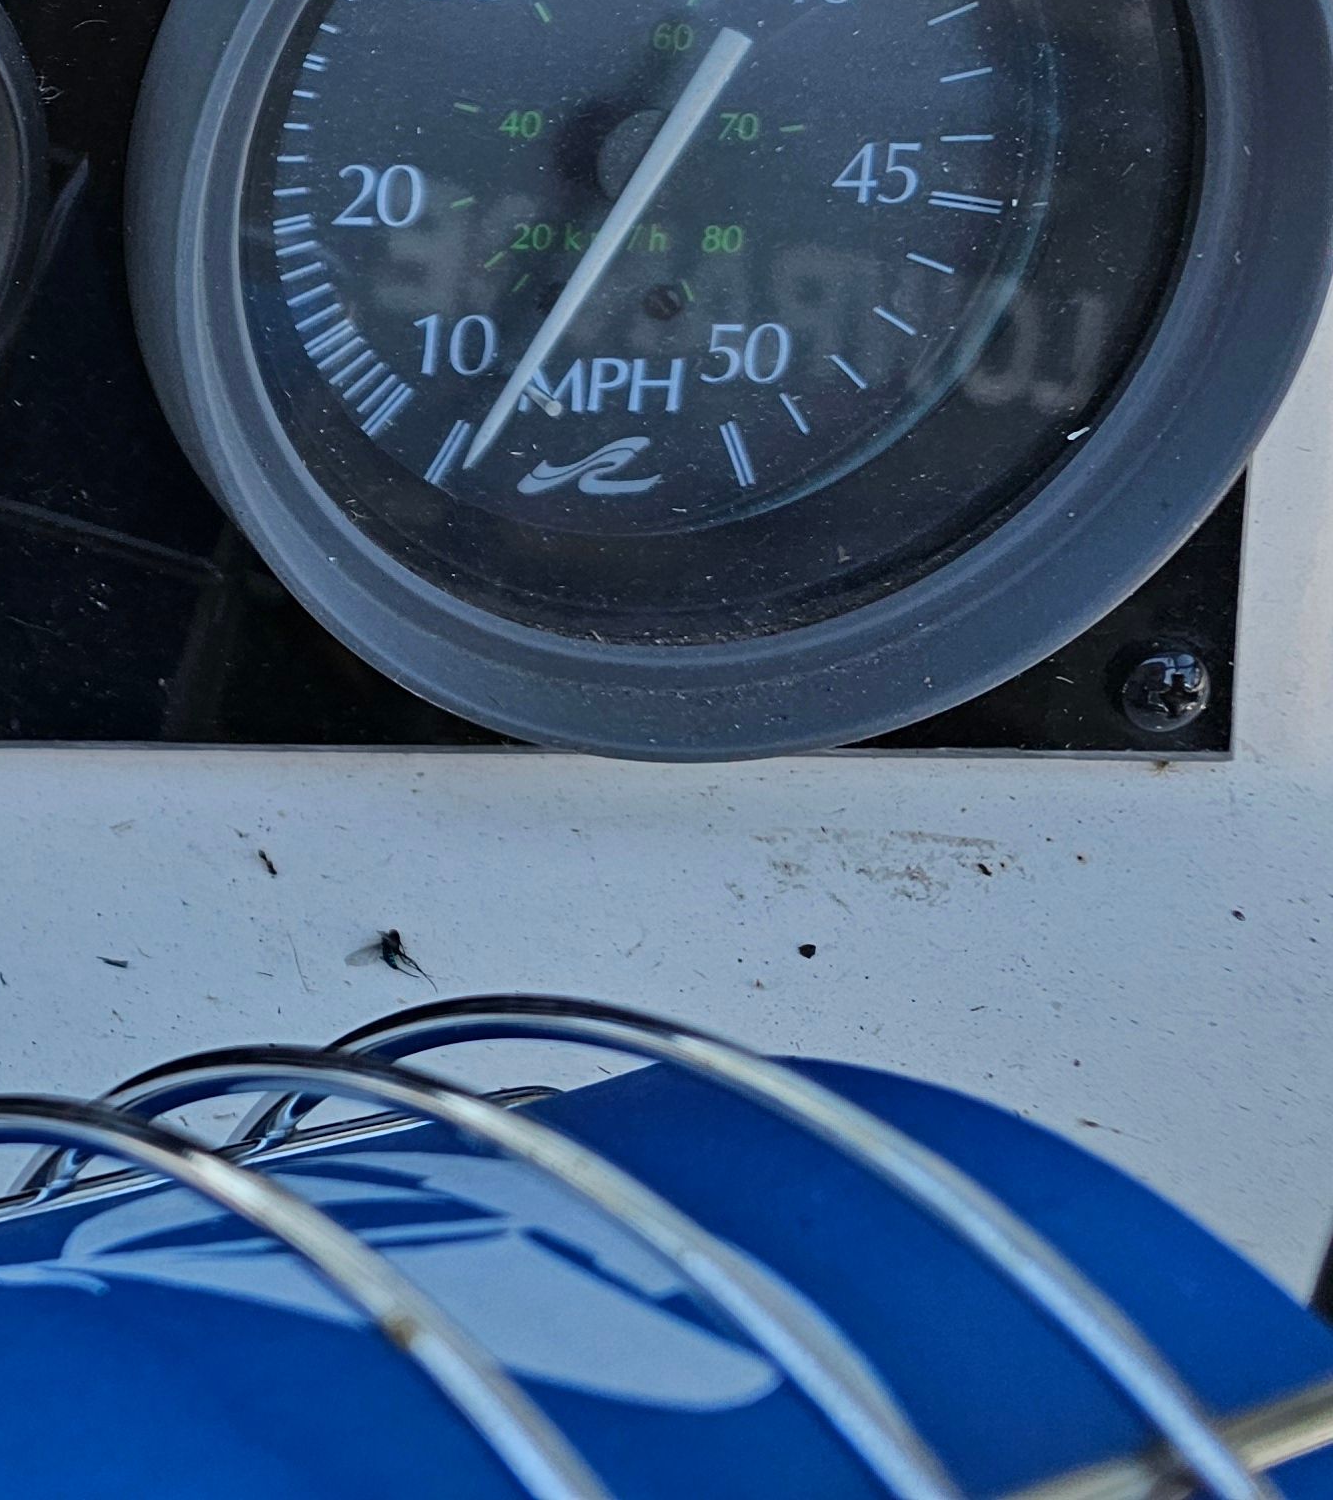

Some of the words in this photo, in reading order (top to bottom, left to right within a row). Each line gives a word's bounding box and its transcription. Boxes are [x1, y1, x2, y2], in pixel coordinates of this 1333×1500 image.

[653, 23, 693, 52] 60
[498, 111, 543, 139] 40
[719, 113, 760, 141] 70
[832, 142, 923, 205] 45
[333, 166, 423, 228] 20
[511, 224, 553, 250] 20
[563, 223, 668, 252] k/h
[702, 225, 744, 252] 80
[413, 314, 497, 375] 10
[699, 323, 790, 384] 50
[518, 357, 685, 413] MPH
